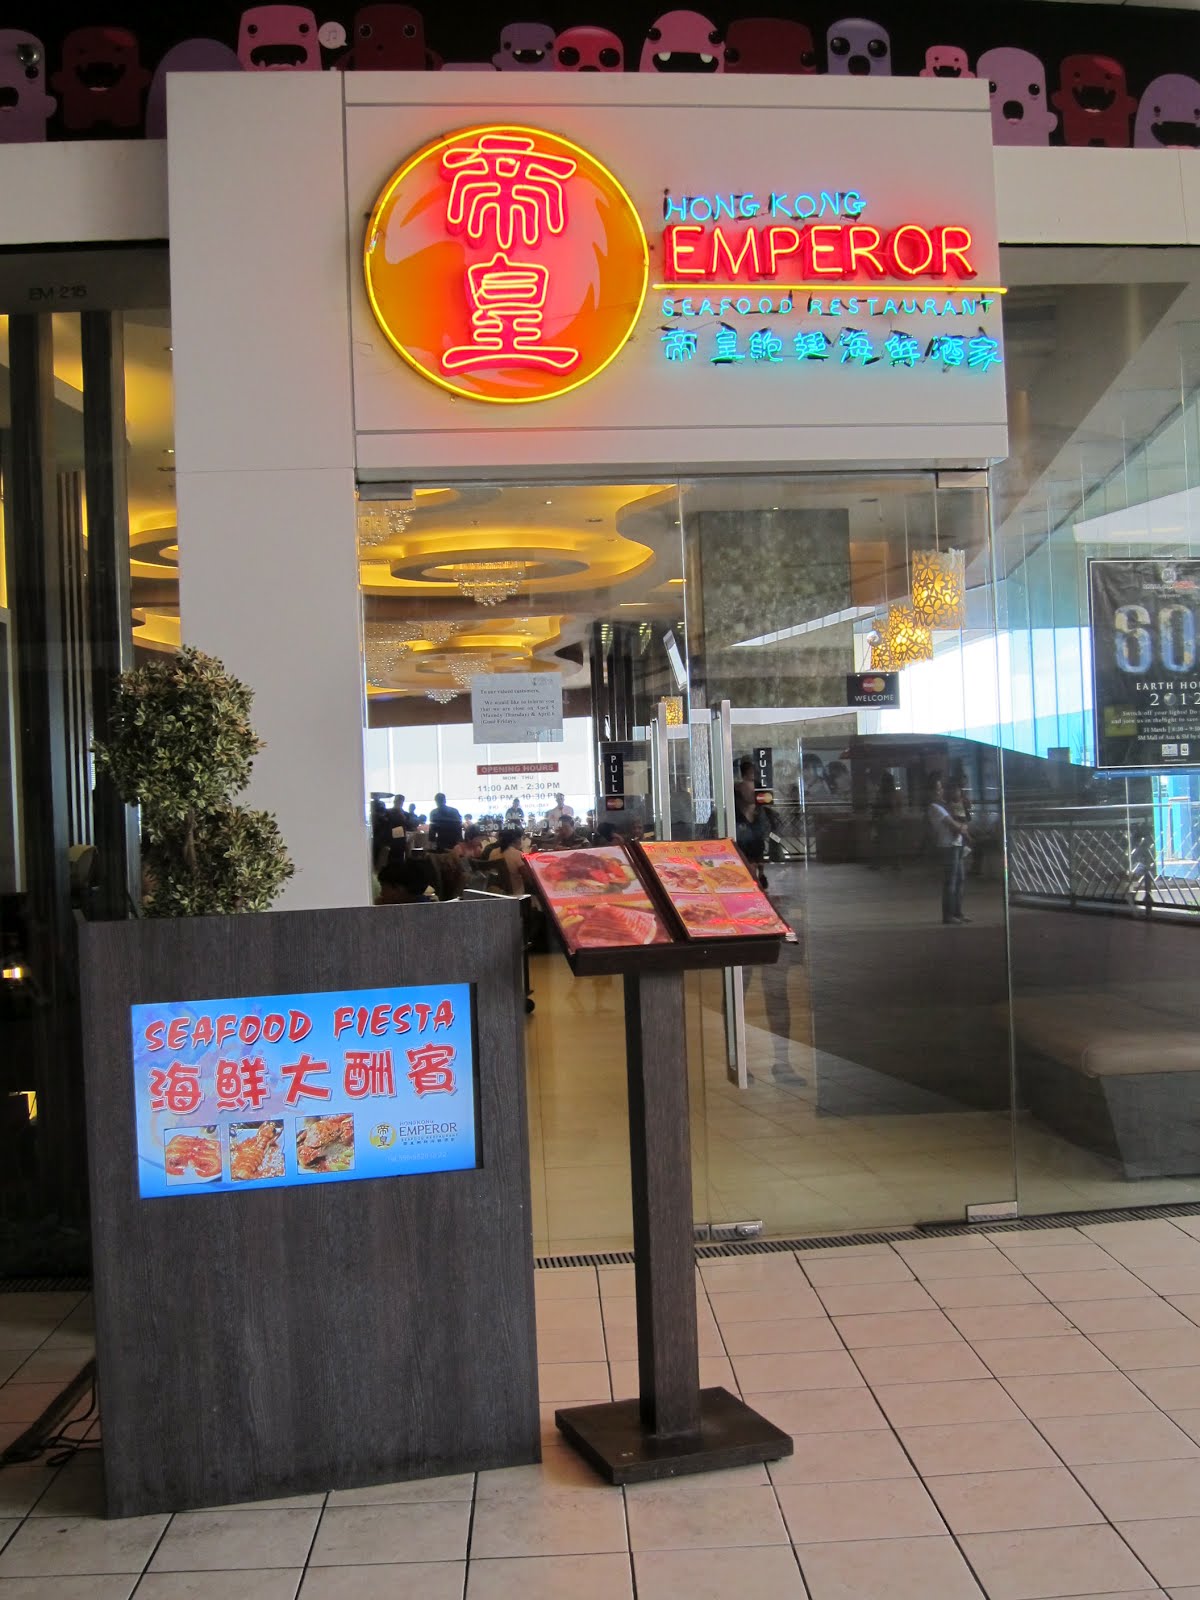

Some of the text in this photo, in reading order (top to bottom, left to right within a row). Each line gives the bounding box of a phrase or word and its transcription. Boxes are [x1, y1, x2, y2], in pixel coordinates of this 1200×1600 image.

[665, 191, 867, 221] HONG KONG
[441, 134, 580, 374] 帝皇
[665, 224, 977, 280] EMPEROR
[661, 298, 994, 316] SEAFOOD RESTAURANT
[1114, 604, 1195, 674] 60
[854, 694, 894, 702] WELCOME
[1136, 681, 1200, 691] EARTH HO
[481, 764, 554, 773] OPENING HOURS
[610, 755, 618, 793] PULL
[759, 750, 767, 787] PULL
[478, 784, 502, 792] 11:00
[526, 782, 545, 790] 2:30
[480, 824, 499, 832] 5:30
[501, 822, 516, 830] PM
[144, 999, 456, 1052] SEAFOOD FIESTA
[149, 1041, 459, 1115] 海鮮大酬賓
[399, 1122, 458, 1137] EMPEROR
